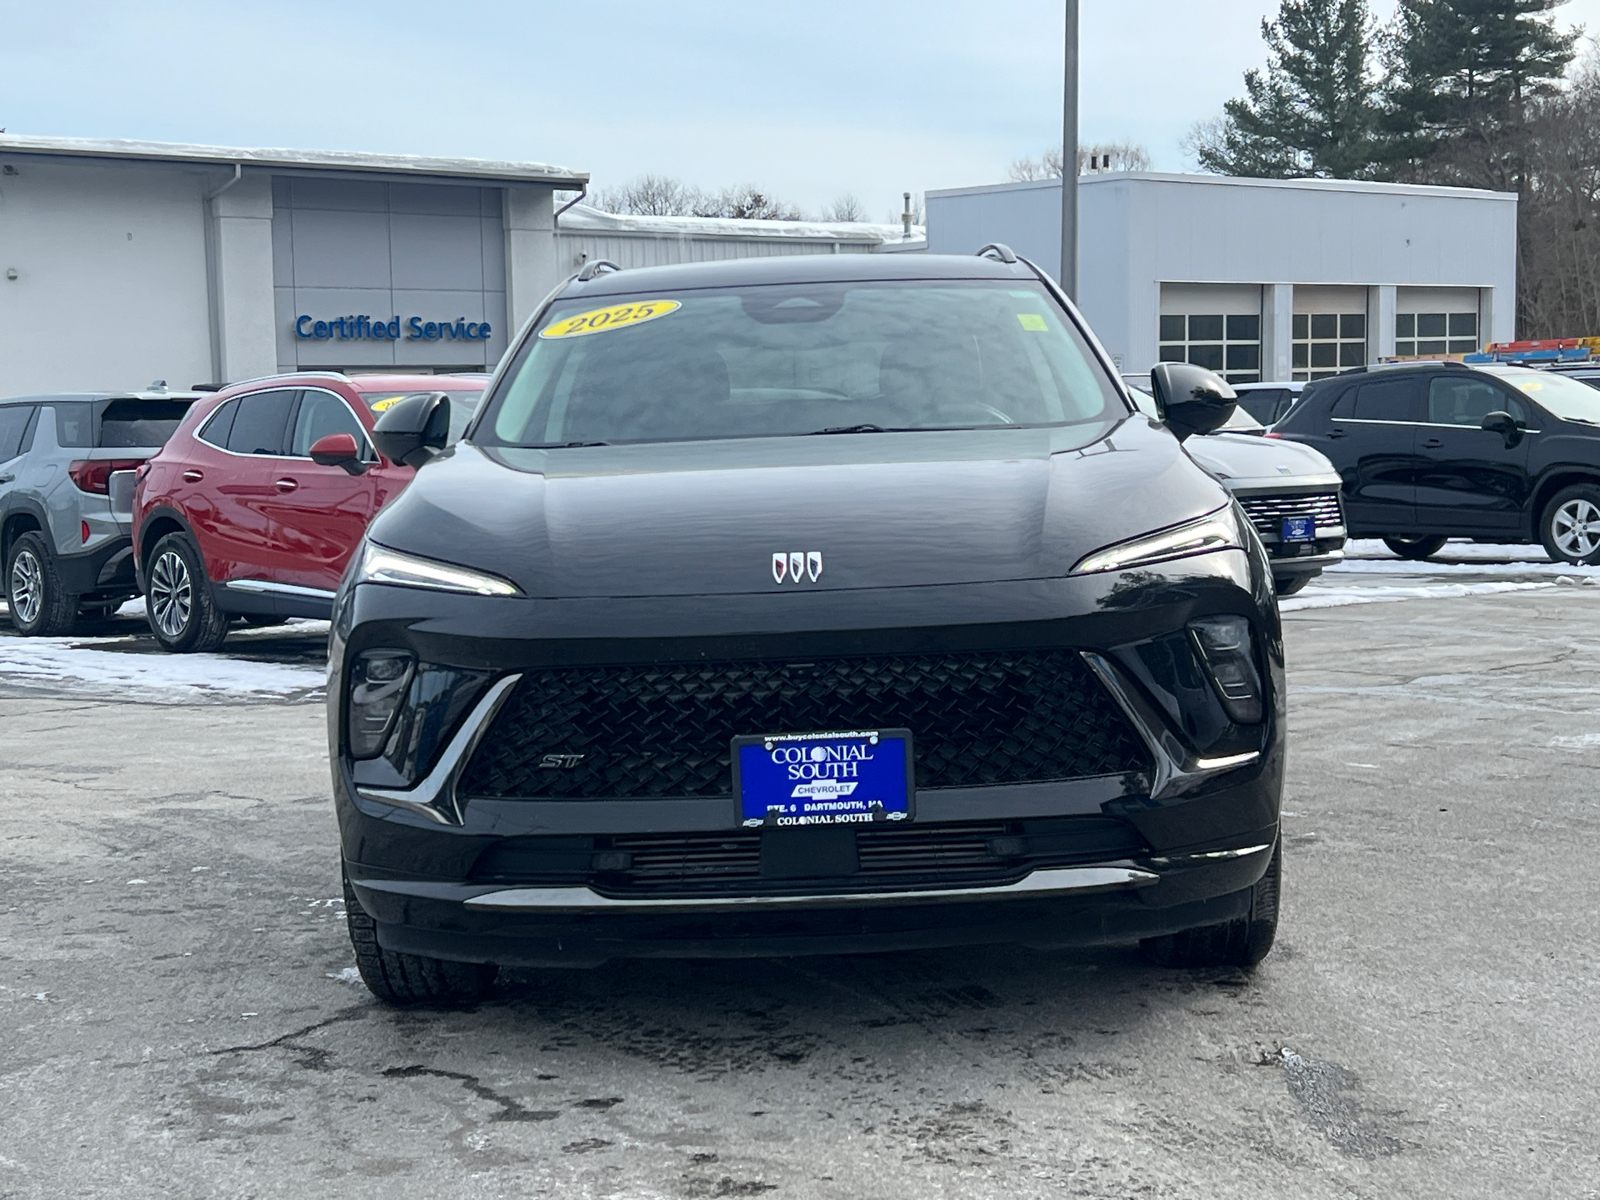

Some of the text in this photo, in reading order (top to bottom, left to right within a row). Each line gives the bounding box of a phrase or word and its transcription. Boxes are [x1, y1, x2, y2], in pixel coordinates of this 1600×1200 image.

[564, 303, 657, 334] 2025
[296, 315, 492, 339] Certified Service
[764, 731, 878, 742] www.buycolonialsouth.com
[539, 754, 585, 768] ST
[771, 745, 874, 764] COLONIAL
[788, 762, 858, 780] SOUTH
[798, 785, 851, 794] CHEVROLET
[790, 804, 797, 812] 6
[804, 801, 866, 811] DARTMOUTH,
[777, 813, 874, 826] COLONIAL SOUTH
